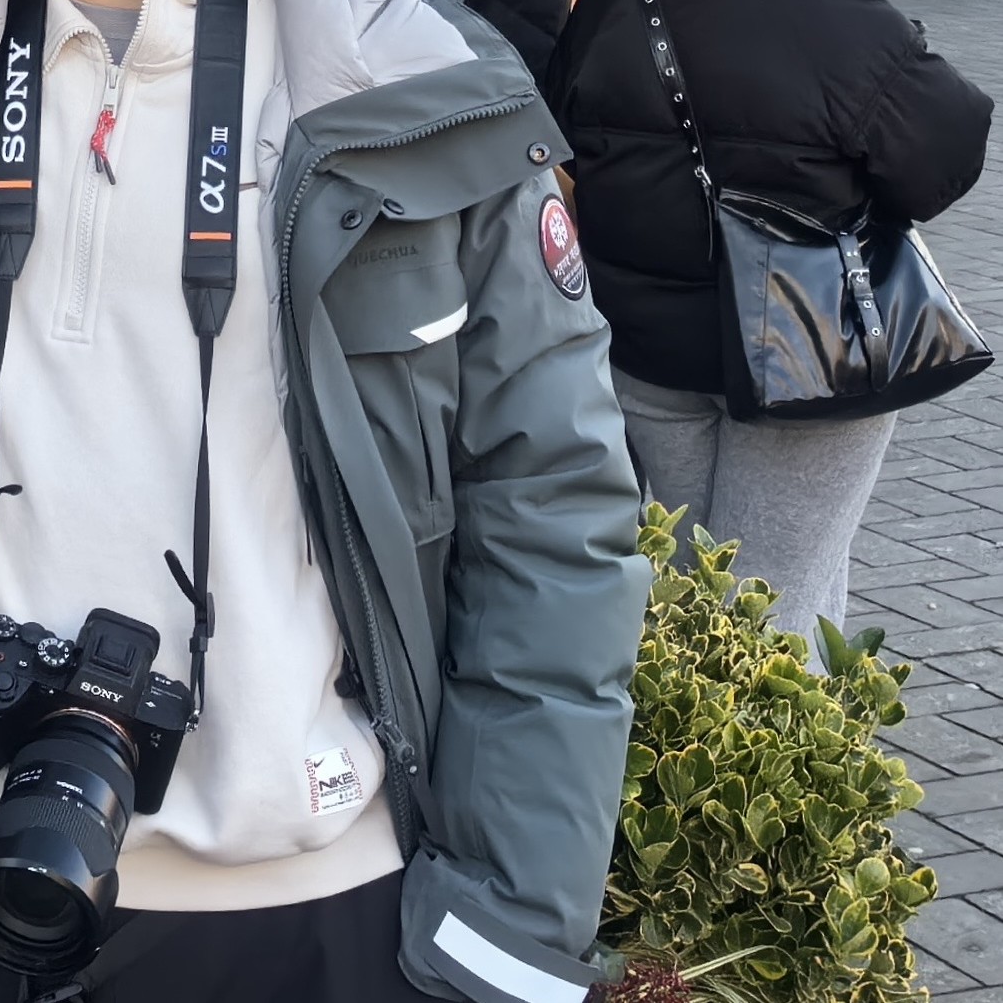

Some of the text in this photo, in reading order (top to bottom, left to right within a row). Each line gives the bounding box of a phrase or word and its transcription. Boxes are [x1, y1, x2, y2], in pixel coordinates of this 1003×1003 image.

[1, 37, 31, 163] SONY
[80, 681, 124, 703] SONY
[318, 771, 356, 792] NIKE
